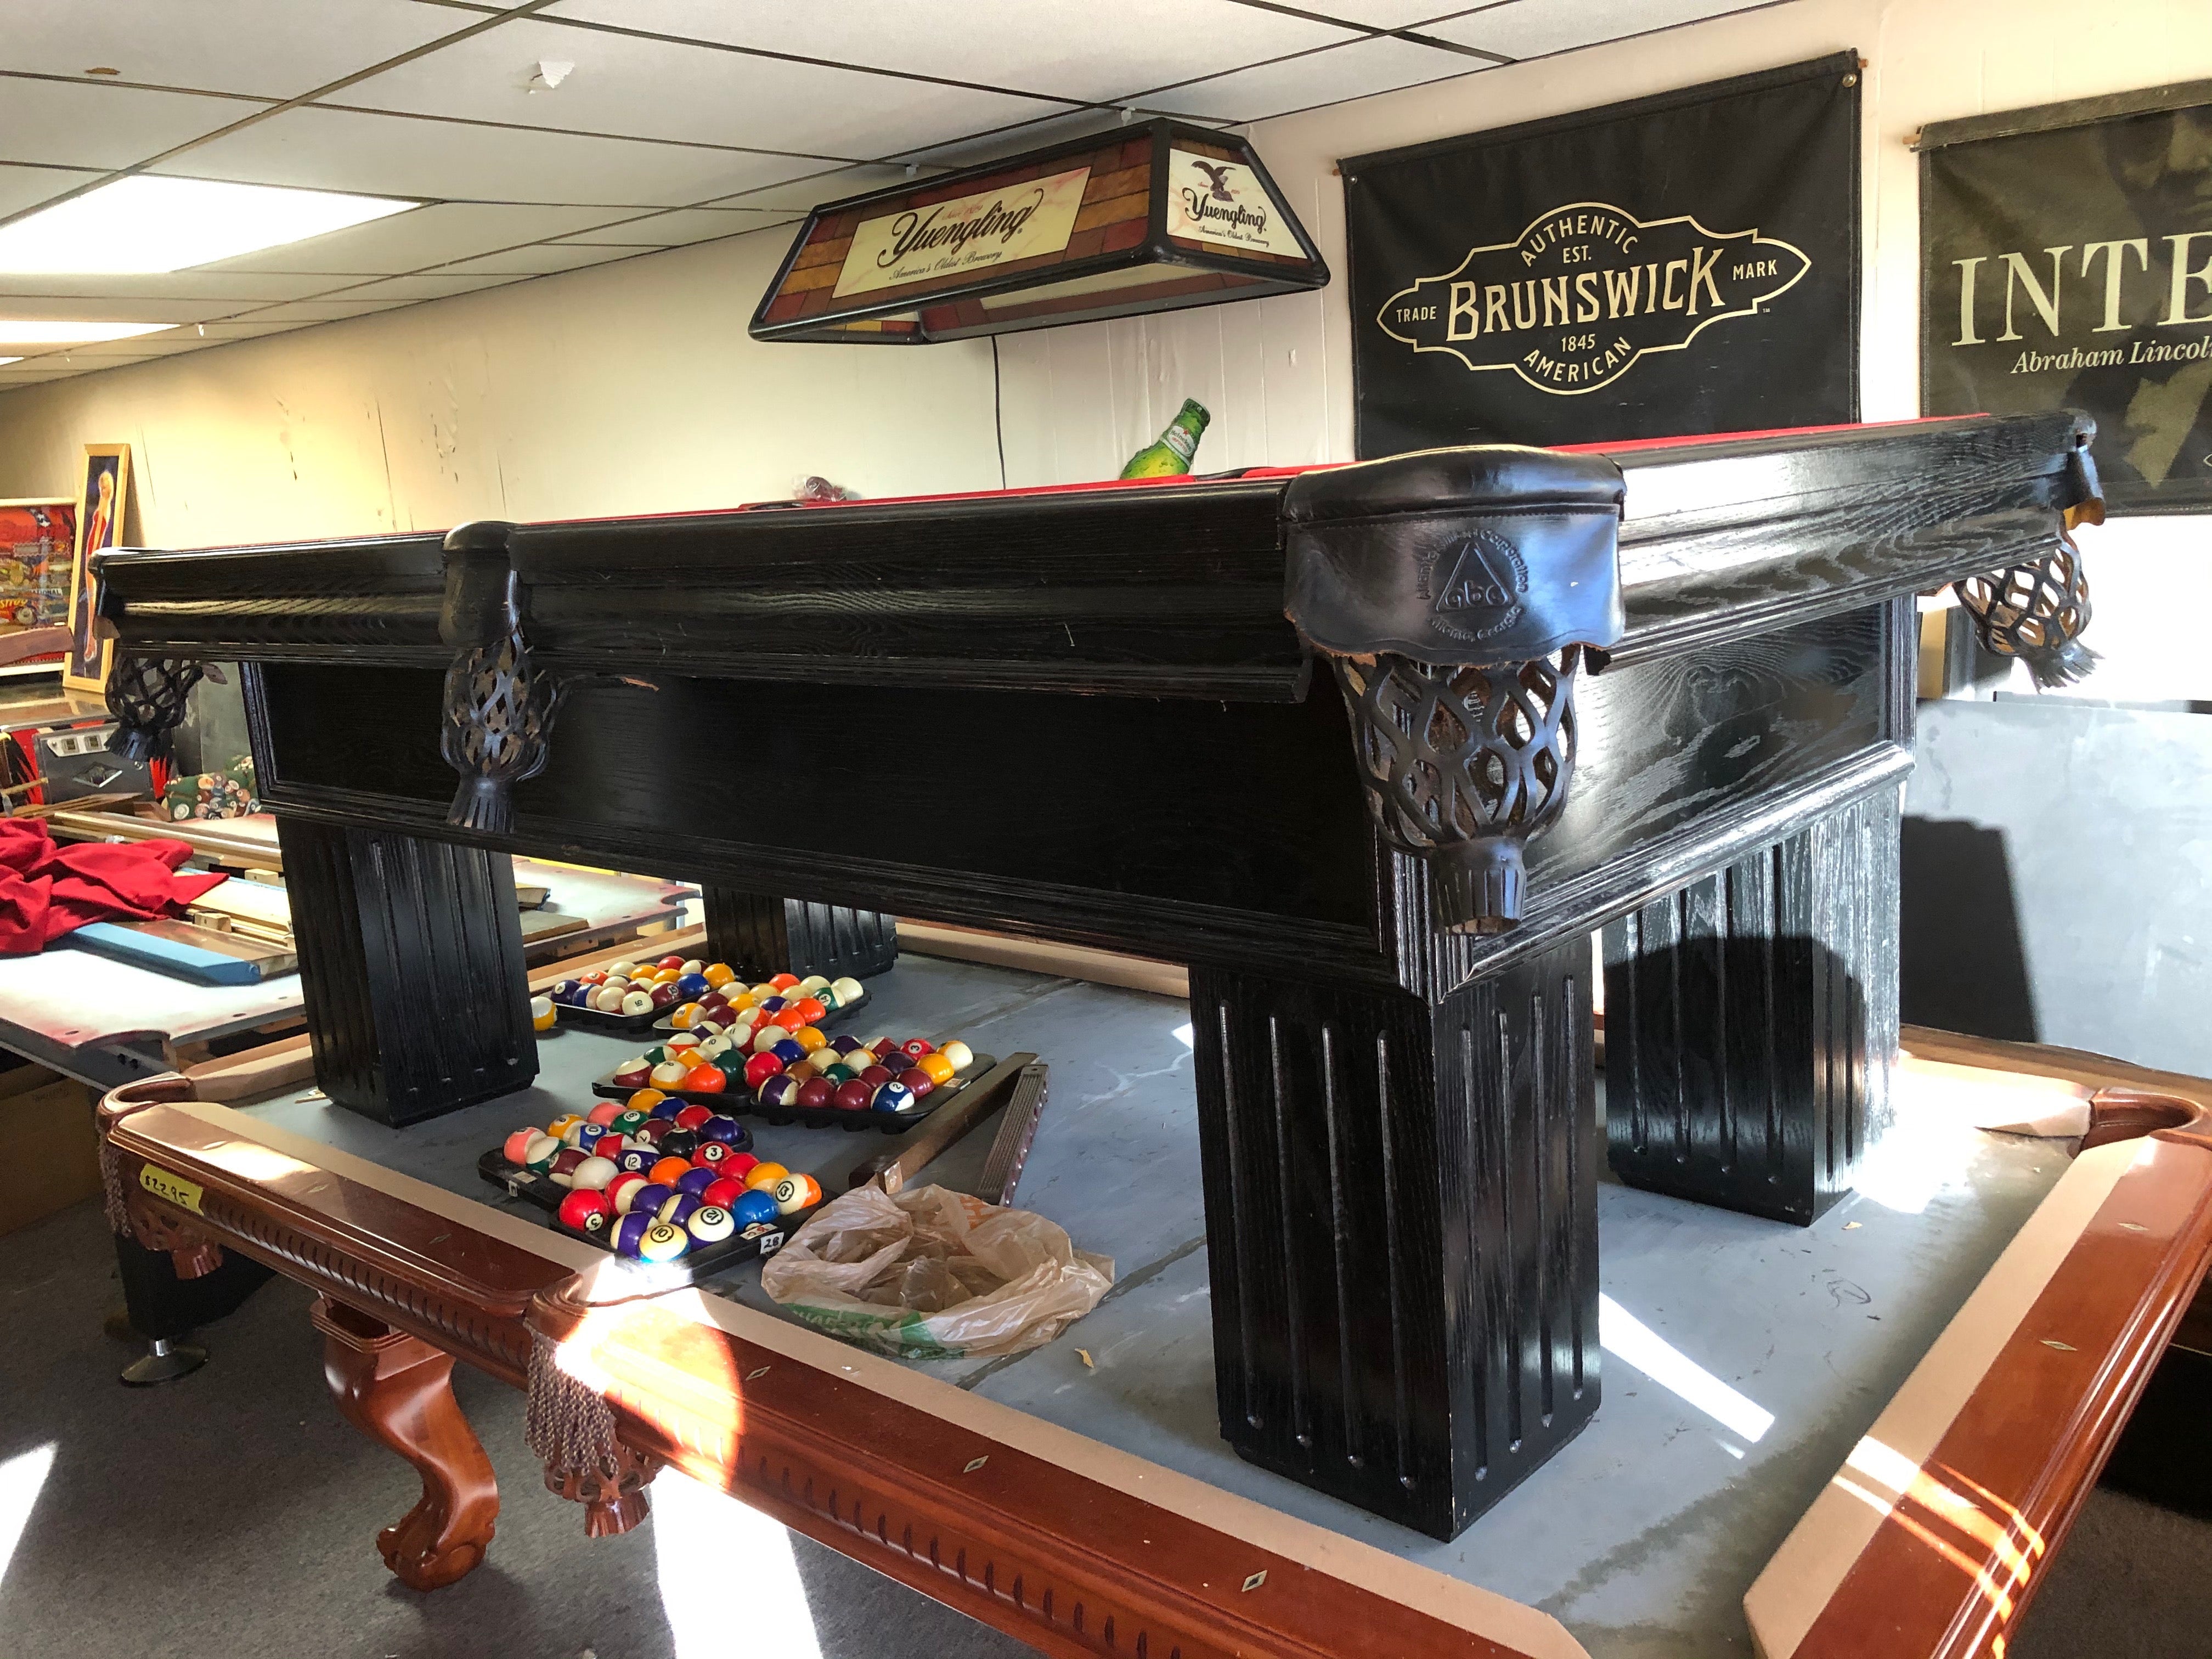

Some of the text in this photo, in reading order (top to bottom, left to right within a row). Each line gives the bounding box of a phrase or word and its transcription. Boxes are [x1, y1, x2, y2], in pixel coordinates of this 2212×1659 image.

[1182, 187, 1266, 234] Yuengling
[877, 188, 1043, 268] Yuengling
[1521, 215, 1638, 267] AUTHENTIC
[889, 251, 1003, 280] America's Oldest Brewery
[1563, 245, 1592, 264] EST.
[1733, 259, 1778, 281] MARK
[1446, 246, 1725, 341] BRUNSWICK
[1396, 306, 1437, 323] TRADE
[1561, 334, 1595, 352] 1845
[1523, 336, 1632, 382] AMERICAN
[2010, 335, 2212, 374] Abraham Lincol
[628, 1156, 637, 1167] 12
[710, 1148, 718, 1157] 3
[778, 1185, 789, 1197] 13
[656, 1228, 668, 1238] 10
